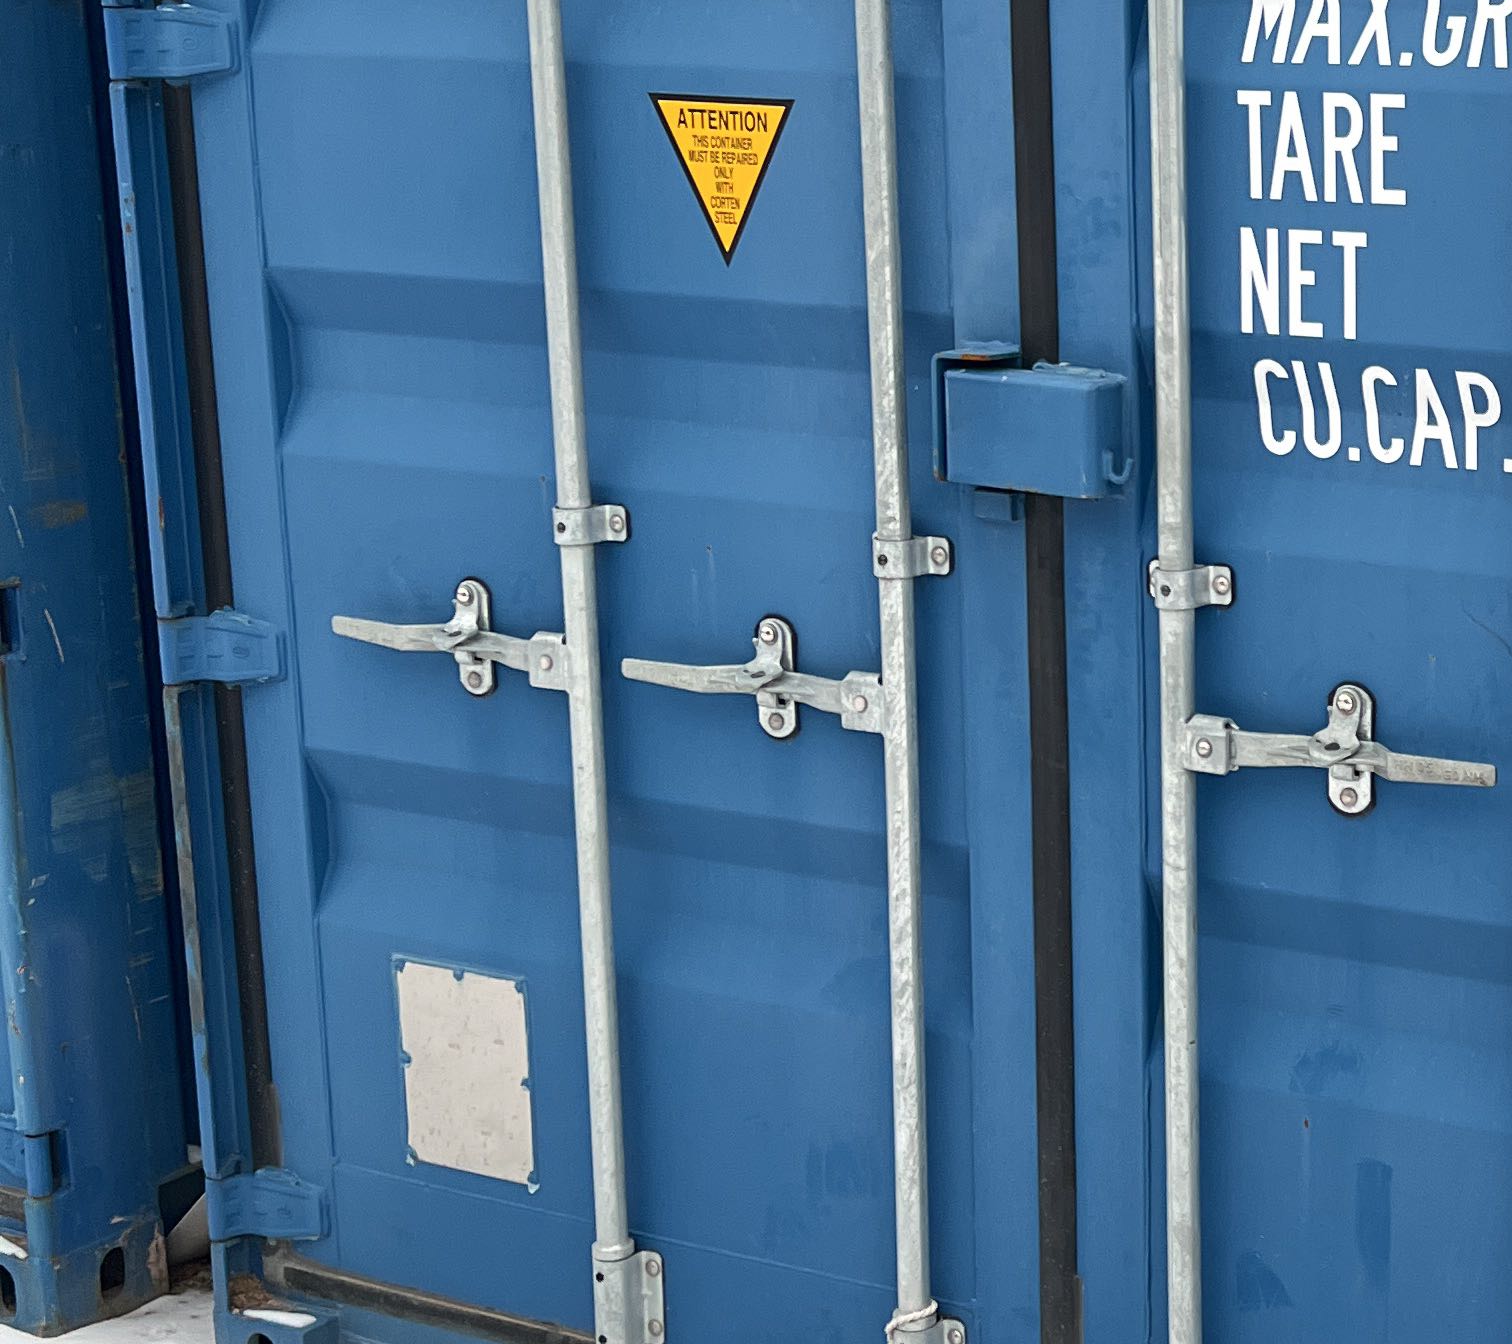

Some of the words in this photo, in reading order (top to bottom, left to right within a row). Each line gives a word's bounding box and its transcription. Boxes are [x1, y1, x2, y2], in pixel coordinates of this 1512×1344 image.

[677, 108, 768, 133] ATTENTION
[691, 134, 709, 148] THIS
[710, 136, 753, 150] CONTAINER
[1237, 90, 1407, 206] TARE
[688, 150, 708, 163] MUST
[710, 151, 721, 164] BE
[721, 152, 759, 166] REPAIRED
[714, 166, 734, 179] ONLY
[715, 182, 734, 194] WITH
[710, 196, 741, 210] CORTEN
[714, 211, 738, 224] STEEL
[1239, 227, 1368, 340] NET
